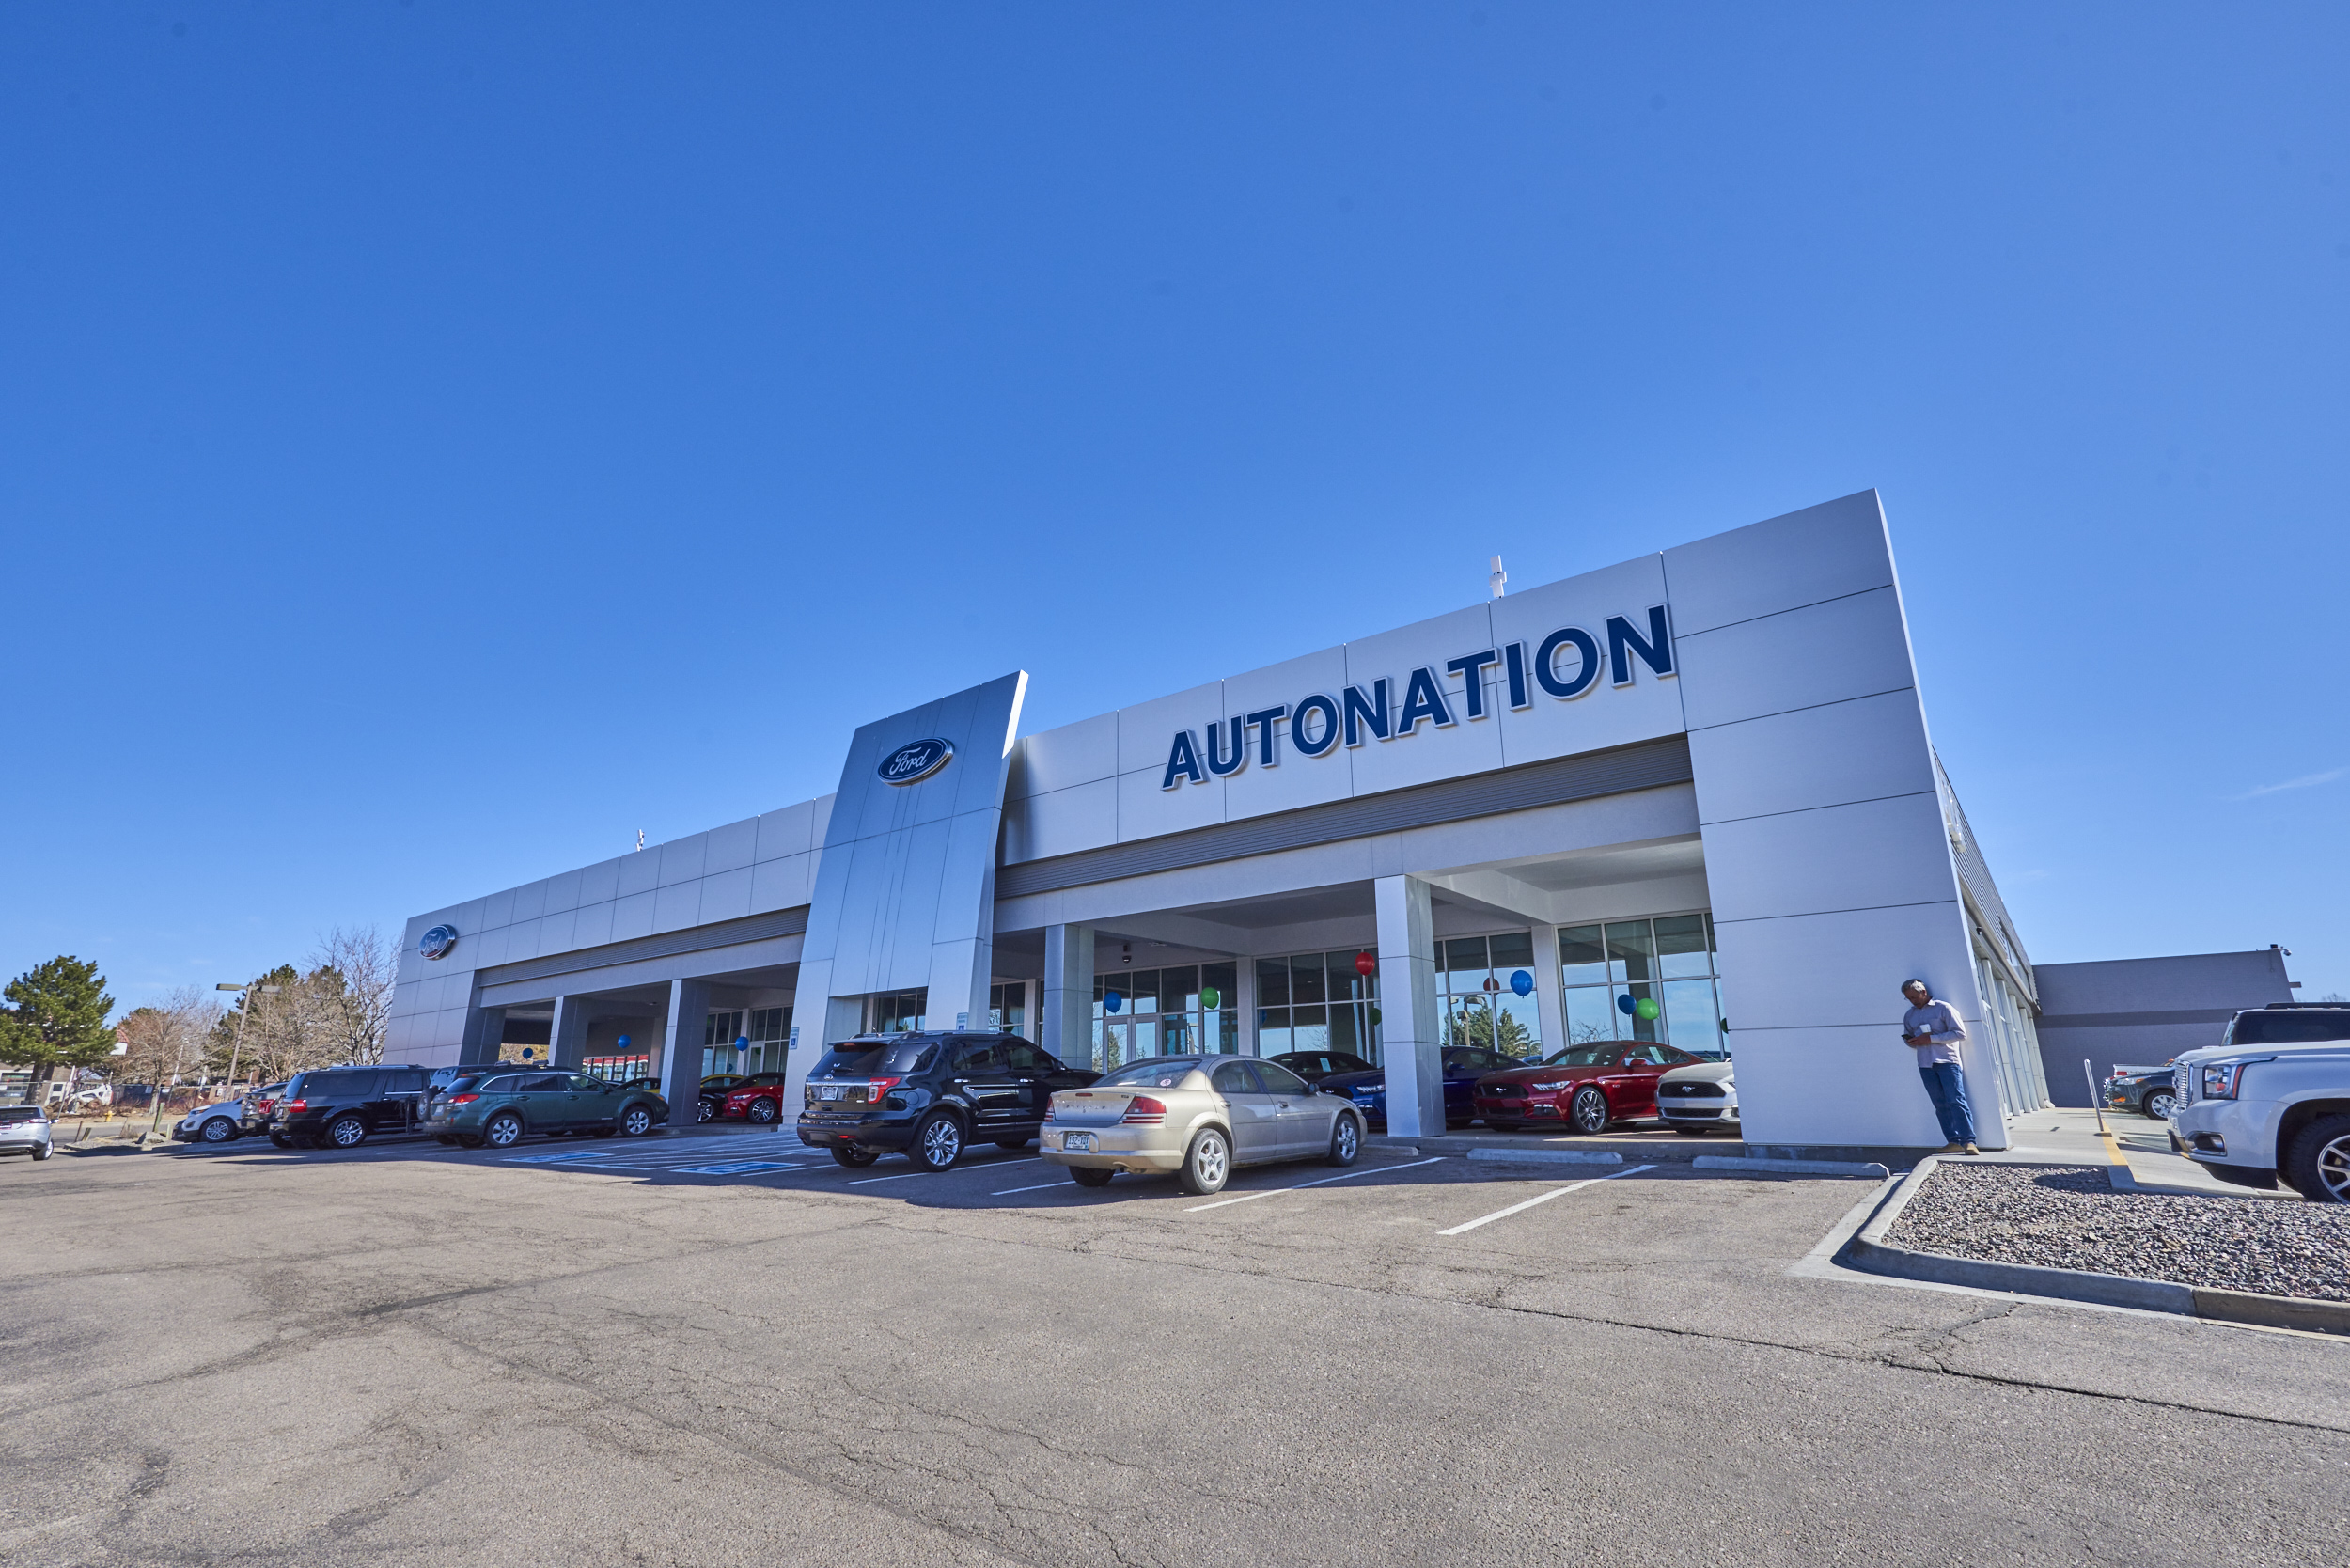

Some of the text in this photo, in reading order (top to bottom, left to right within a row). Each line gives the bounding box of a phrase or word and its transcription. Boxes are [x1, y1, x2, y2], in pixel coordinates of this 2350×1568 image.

[1161, 603, 1677, 791] AUTONATION
[888, 746, 931, 776] Ford
[423, 933, 442, 956] Ford
